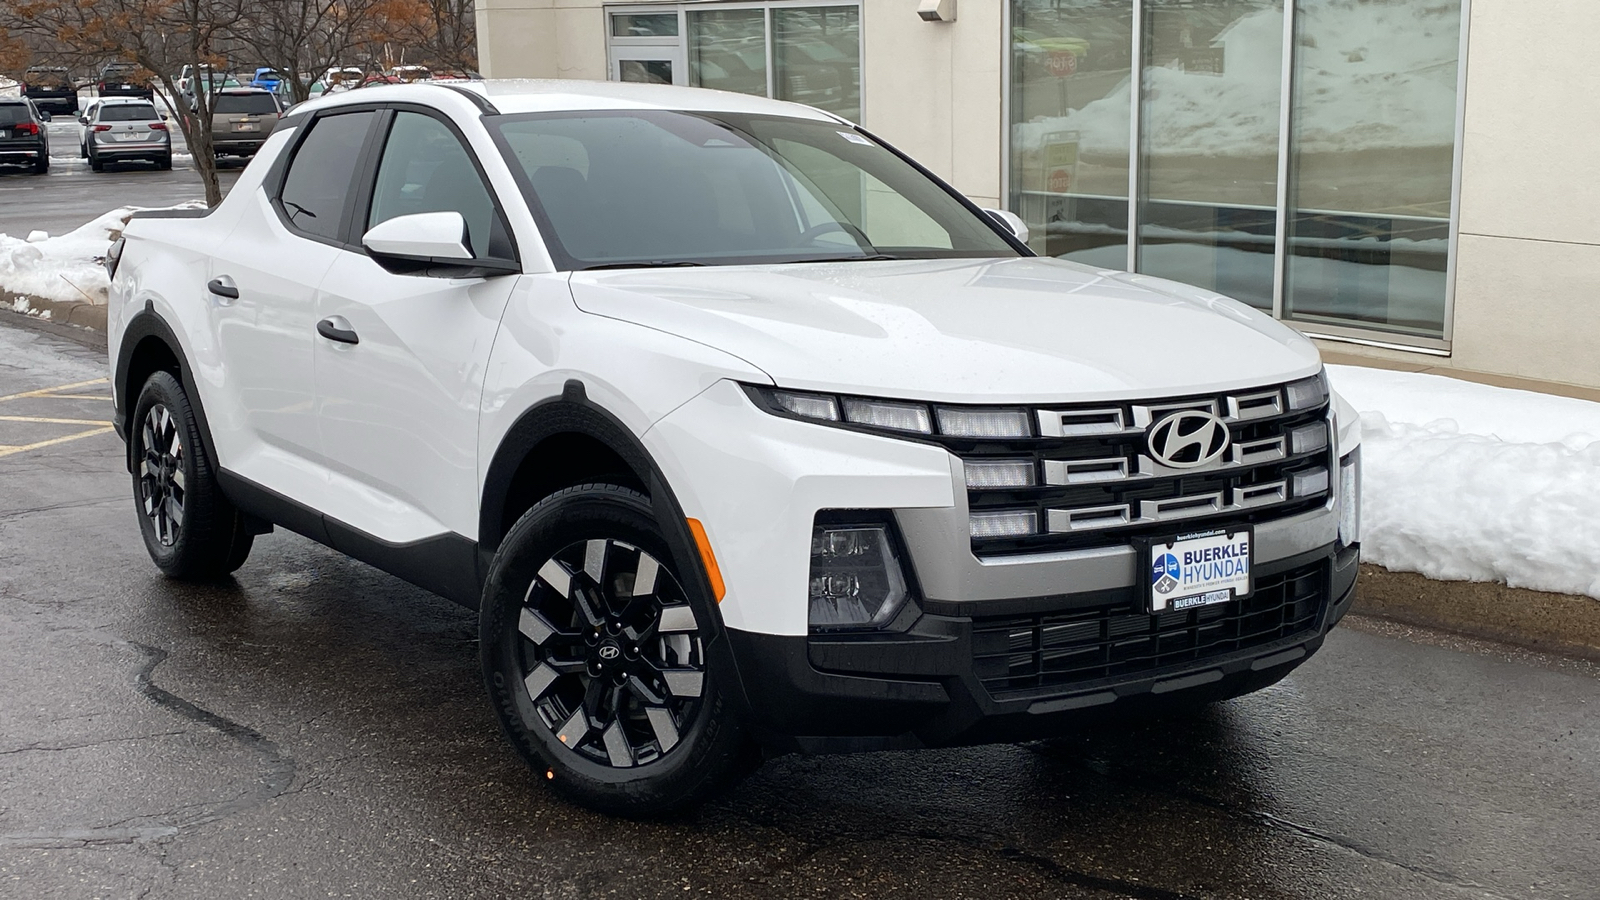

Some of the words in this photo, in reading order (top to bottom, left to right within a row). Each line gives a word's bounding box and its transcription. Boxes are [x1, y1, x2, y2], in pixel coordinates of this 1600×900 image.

[1177, 529, 1226, 540] buerklehyundai.com
[1184, 542, 1248, 565] BUERKLE
[1184, 557, 1248, 585] HYUNDAI
[1175, 595, 1206, 608] BUERKLE
[1206, 591, 1229, 603] HYUNDAI
